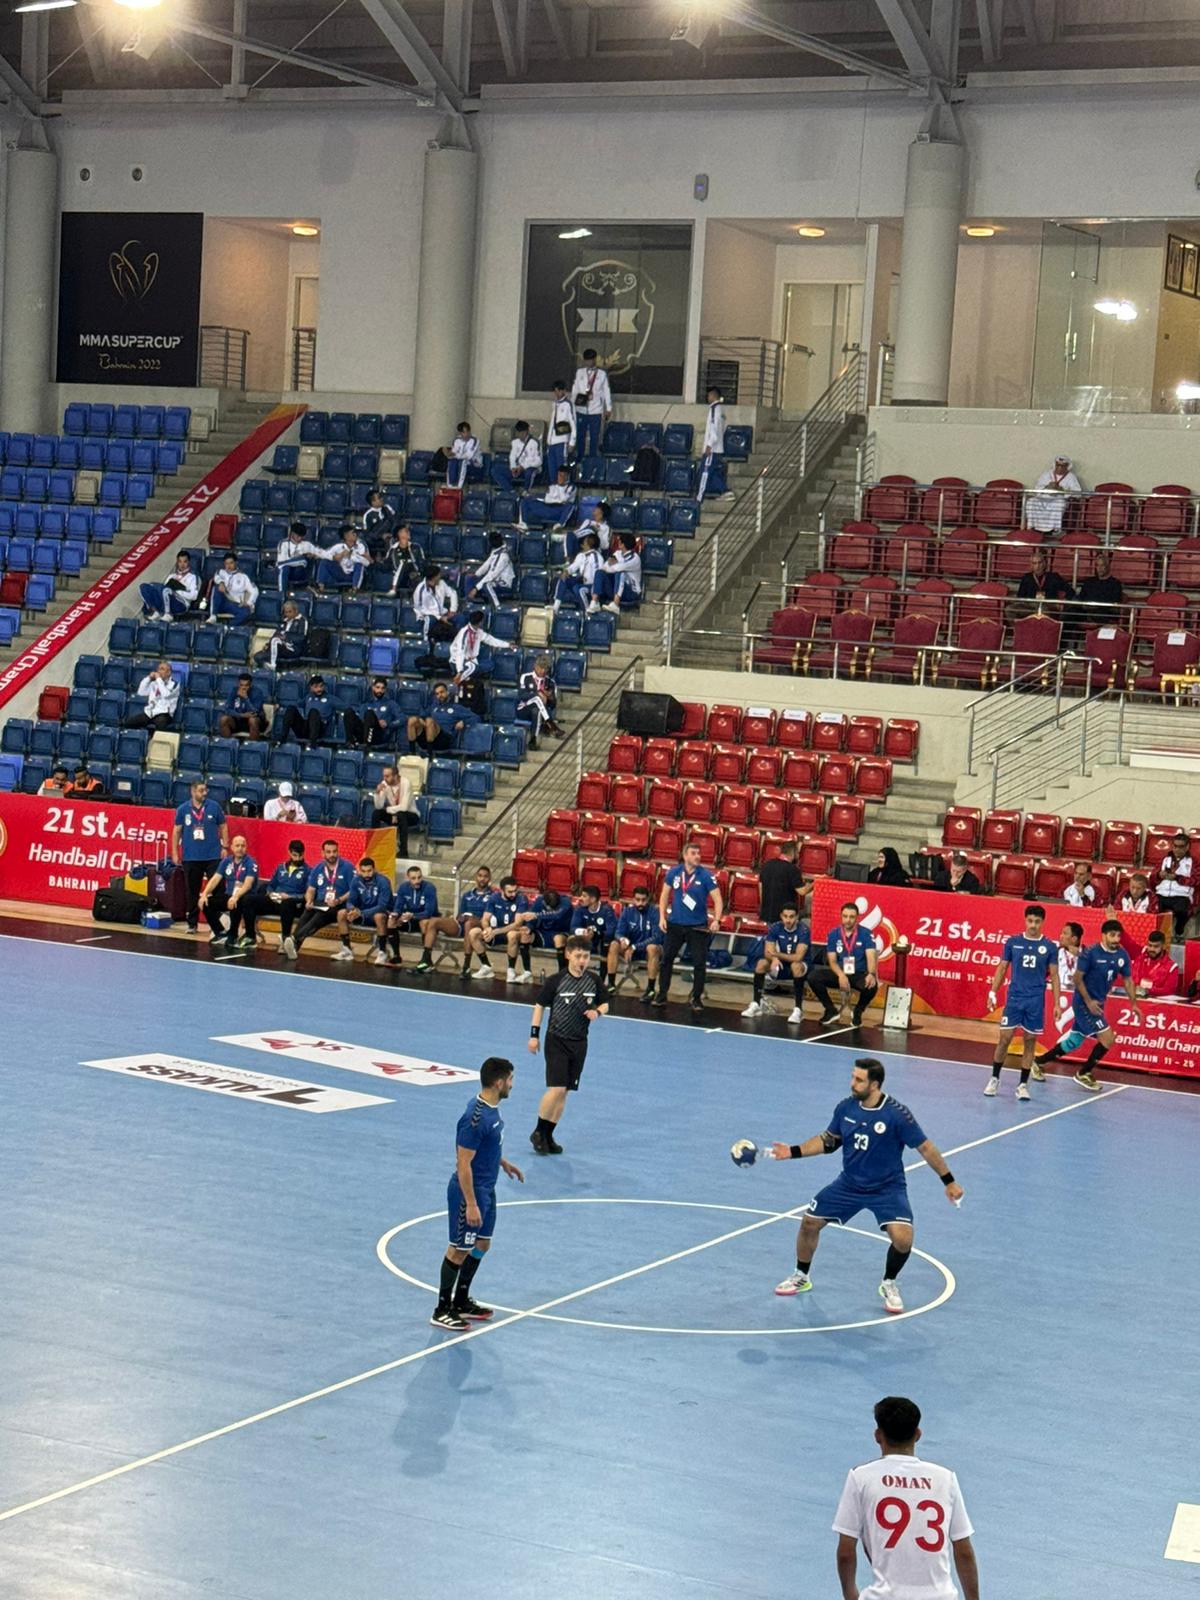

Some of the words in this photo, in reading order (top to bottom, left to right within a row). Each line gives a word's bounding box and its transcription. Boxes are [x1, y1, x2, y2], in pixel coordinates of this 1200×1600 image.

[138, 359, 161, 370] 2022
[185, 484, 219, 504] 21
[127, 525, 170, 562] Asian
[30, 601, 96, 656] Handball
[43, 807, 75, 834] 21
[81, 811, 109, 838] st
[112, 820, 168, 843] Asian
[28, 843, 108, 871] Handball
[110, 852, 157, 872] Cha
[48, 875, 99, 892] BAHRAIN
[916, 917, 943, 937] 21
[948, 921, 972, 940] st
[973, 928, 1012, 944] Asia
[971, 950, 1001, 966] Cha
[1022, 954, 1037, 969] 23
[923, 968, 961, 980] BAHRAIN
[1117, 1009, 1141, 1027] 21
[1145, 1013, 1166, 1030] st
[1113, 1031, 1165, 1049] andball
[1120, 1051, 1158, 1063] BAHRAIN
[126, 1064, 273, 1093] ALKASS
[881, 1474, 932, 1490] OMAN
[875, 1496, 945, 1552] 93
